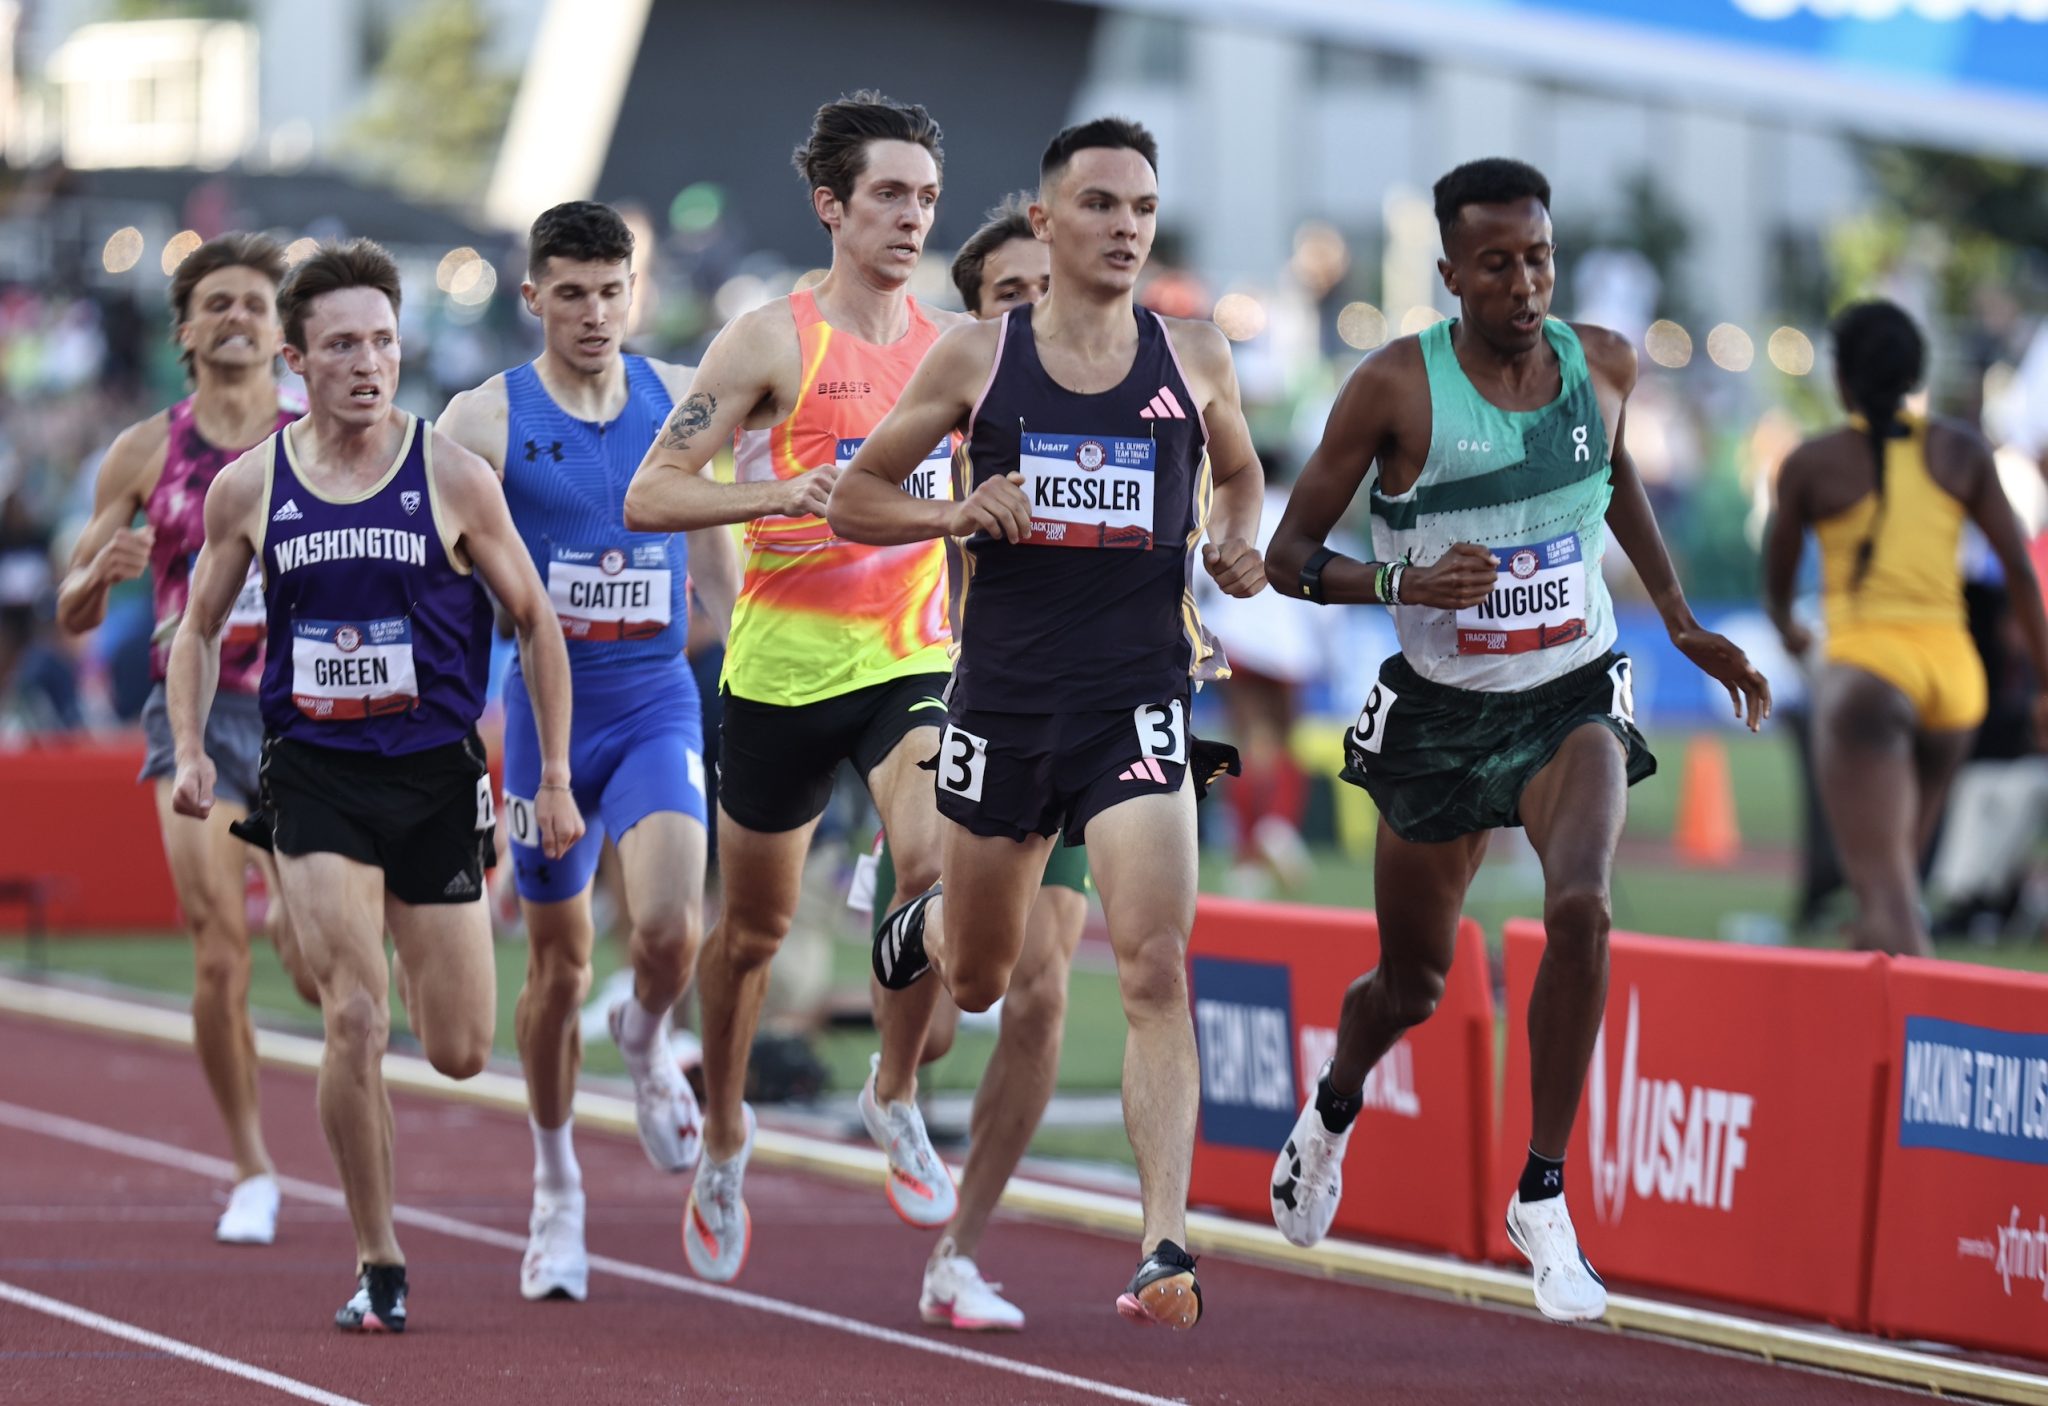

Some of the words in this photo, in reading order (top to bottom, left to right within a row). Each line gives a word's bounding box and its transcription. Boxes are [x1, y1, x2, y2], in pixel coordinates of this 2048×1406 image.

[818, 381, 871, 394] BEASTS
[1041, 443, 1069, 452] USATF
[1114, 442, 1125, 450] U.S.
[1126, 442, 1150, 451] OLYMPIC
[1115, 450, 1130, 458] TEAM
[1130, 450, 1149, 459] TRIALS
[1457, 439, 1492, 452] OAC
[1035, 475, 1141, 511] KESSLER
[1030, 521, 1067, 533] RACKTOWN
[1045, 531, 1064, 541] 2024
[274, 527, 427, 575] WASHINGTON
[569, 580, 650, 608] CIATTEI
[1478, 576, 1570, 619] NUGUSE
[1465, 633, 1508, 643] TRACKTOWN
[1487, 640, 1506, 649] 2024
[315, 656, 389, 686] GREEN
[1355, 684, 1381, 741] 8
[1145, 704, 1177, 756] 3
[946, 732, 974, 792] 3
[1903, 1040, 1973, 1130] MAKING
[1974, 1050, 2021, 1137] TEAM
[2022, 1057, 2048, 1141] US
[1631, 1076, 1756, 1213] USATF
